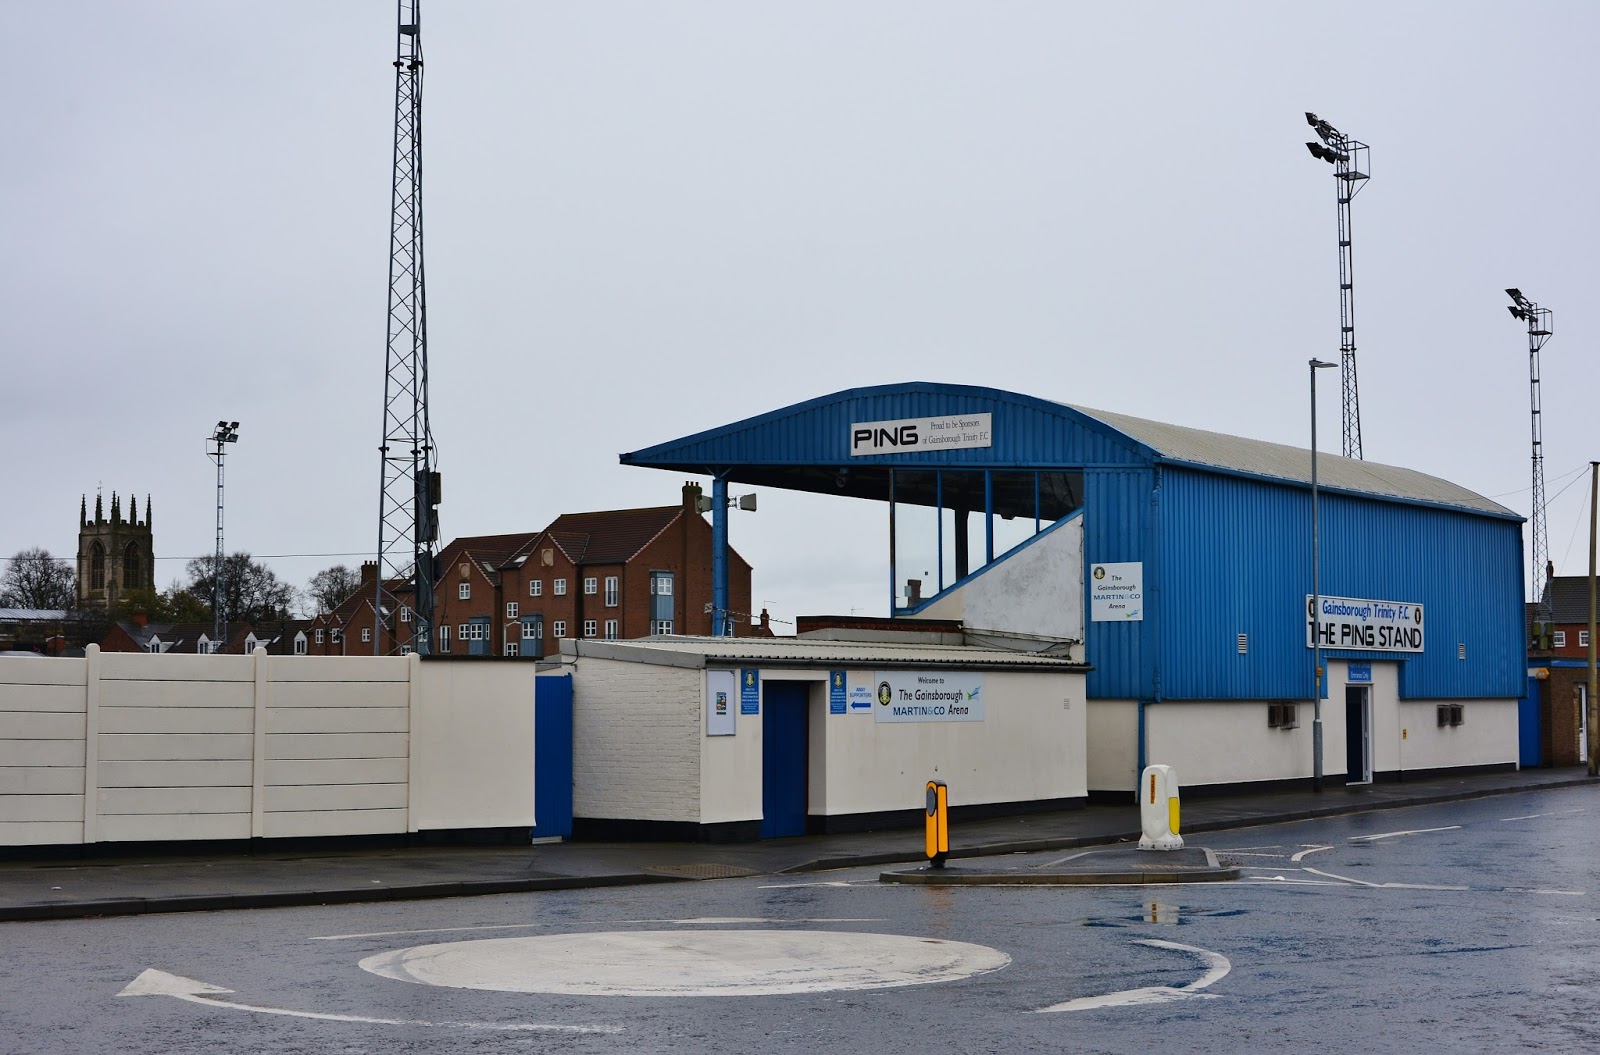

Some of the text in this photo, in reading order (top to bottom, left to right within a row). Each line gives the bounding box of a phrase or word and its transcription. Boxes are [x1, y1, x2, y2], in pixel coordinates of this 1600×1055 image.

[930, 421, 944, 430] Proud
[951, 420, 958, 428] be
[959, 419, 979, 430] Sponsors
[854, 425, 918, 449] PING
[928, 434, 961, 444] Gainsborough
[962, 431, 978, 443] Trinity
[1322, 600, 1410, 623] Gainsborough Trinity F.C.
[1308, 621, 1422, 649] THE PING STAND
[917, 676, 938, 684] Welcome
[899, 689, 963, 703] The Gainsborough
[893, 703, 969, 716] MARTIN&CO Arena
